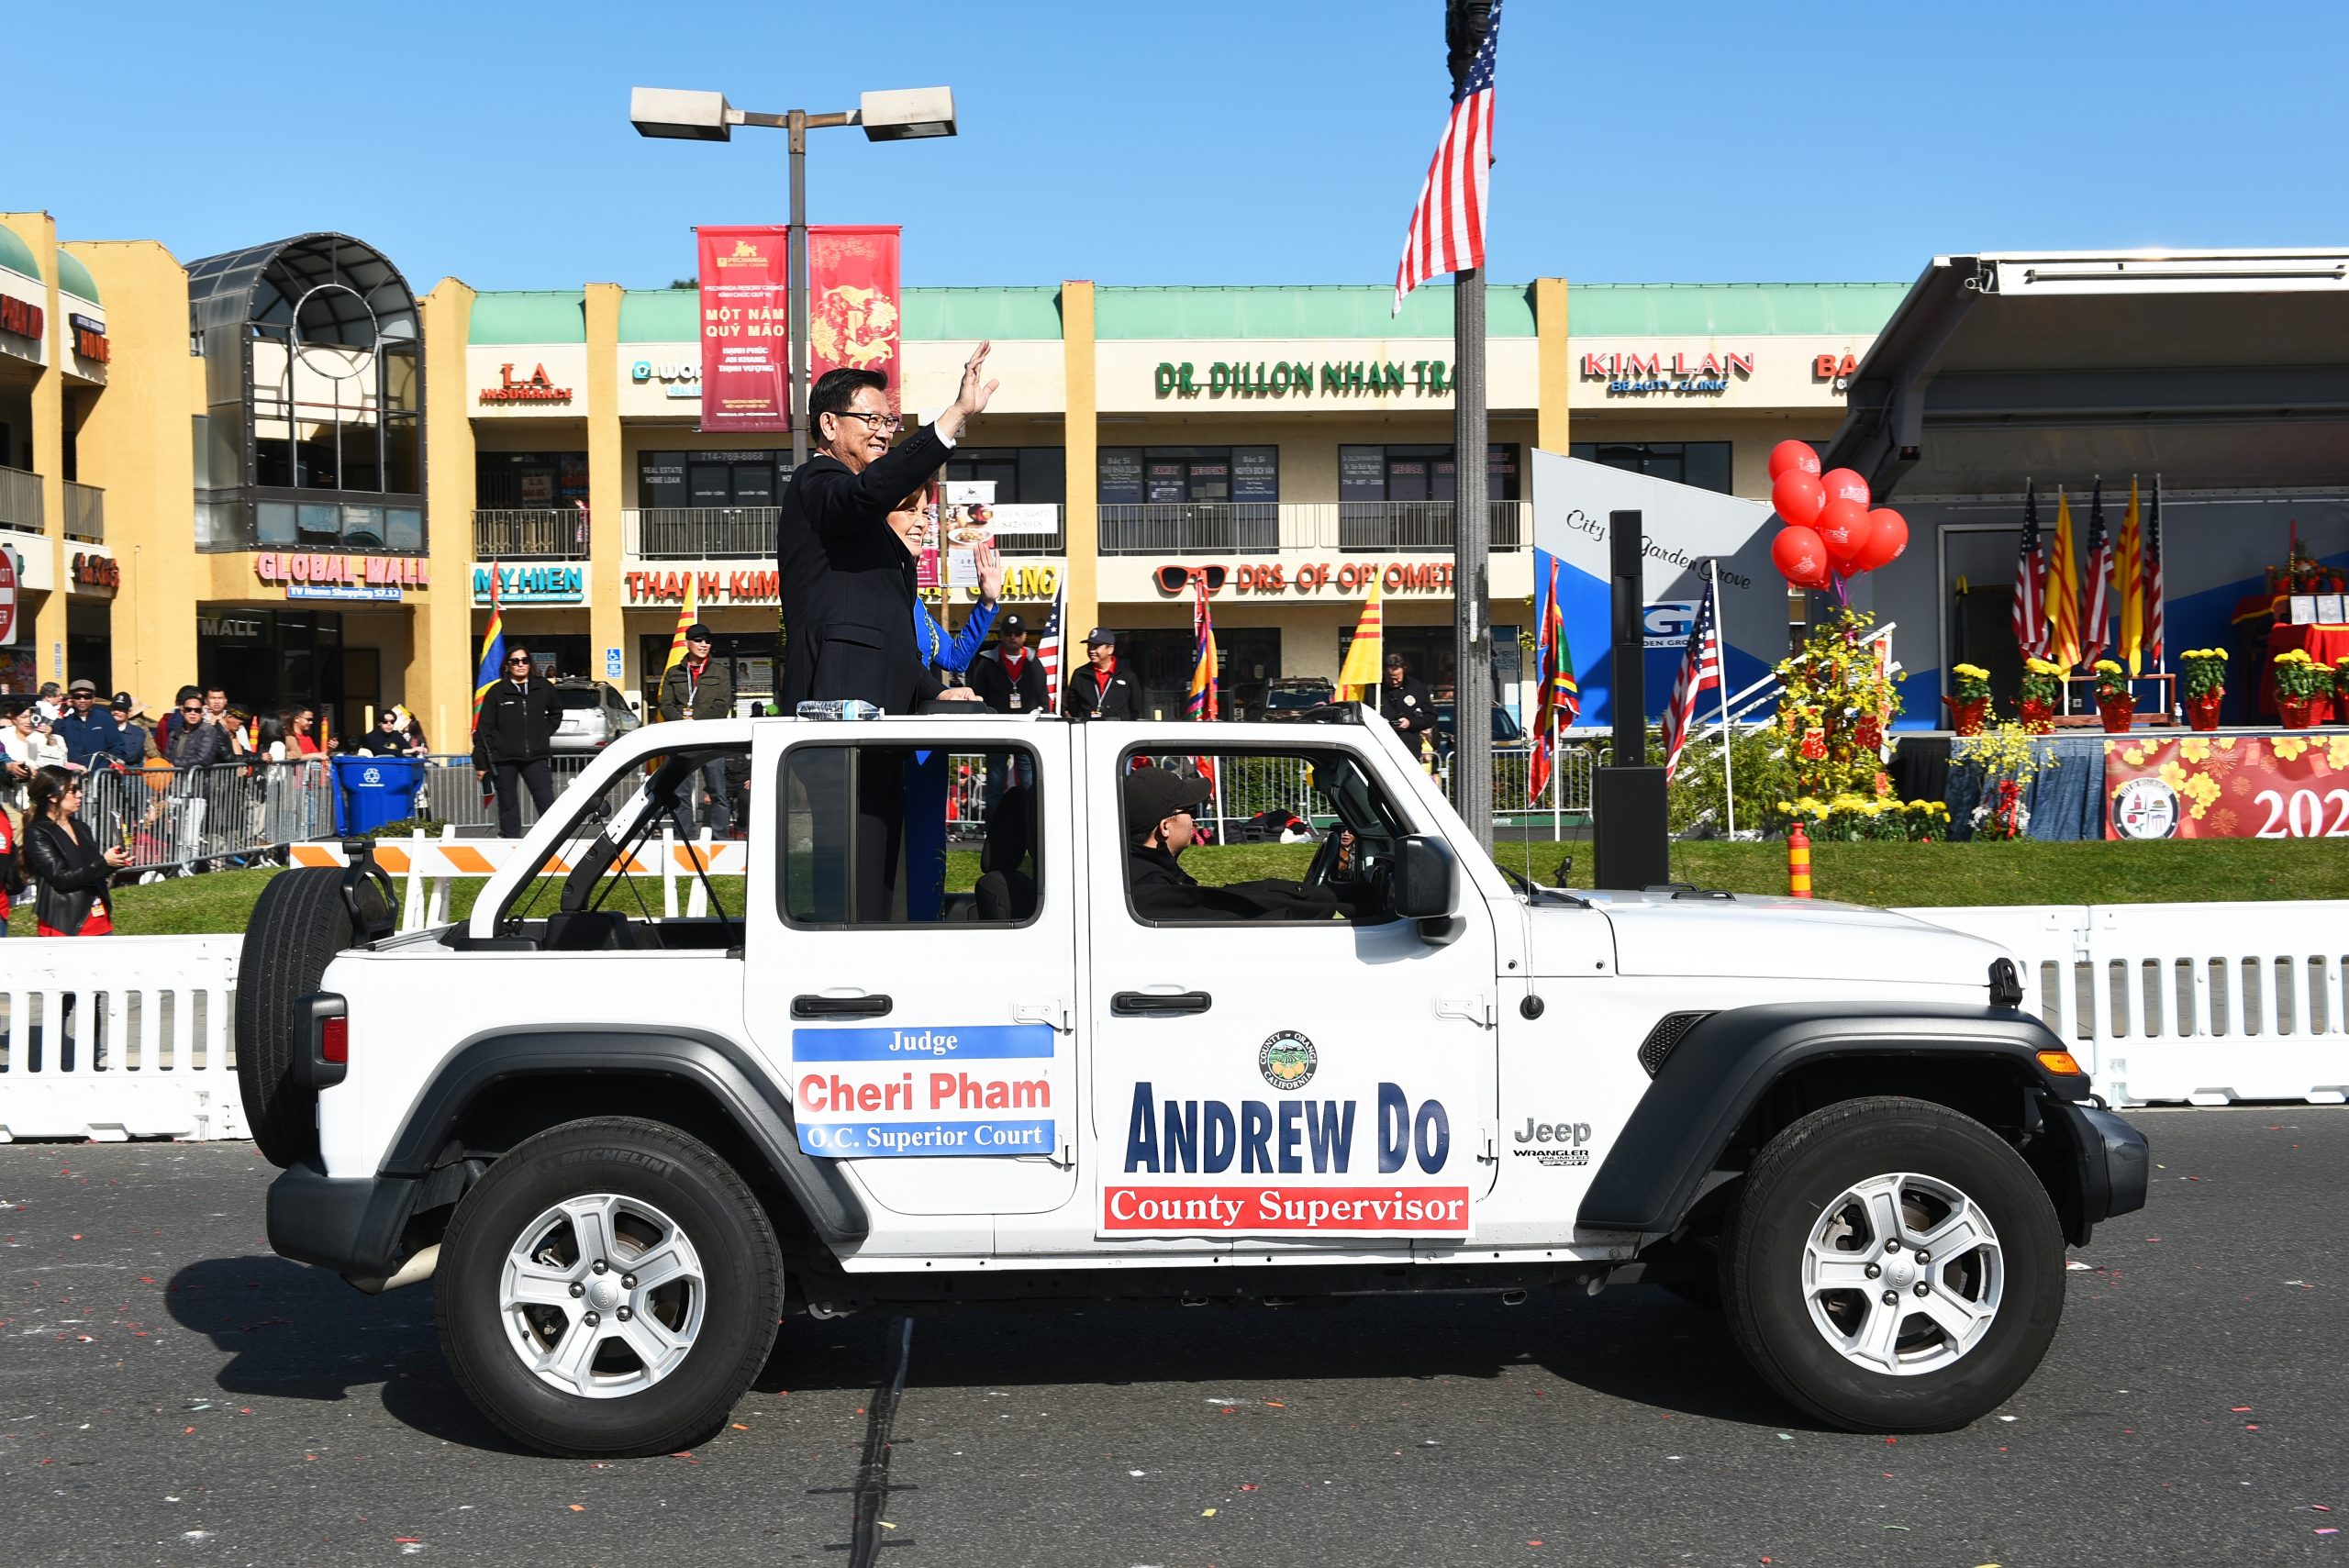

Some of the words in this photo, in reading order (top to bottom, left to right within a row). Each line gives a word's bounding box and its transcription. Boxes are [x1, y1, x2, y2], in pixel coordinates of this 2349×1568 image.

[706, 306, 740, 322] MỘT
[748, 306, 785, 320] NĂM
[748, 323, 785, 337] MÃO
[502, 362, 553, 386] LA
[1583, 351, 1663, 375] KIM
[1674, 351, 1754, 375] LAN
[1158, 361, 1202, 393] DR.
[1210, 361, 1314, 392] DILLON
[1324, 360, 1405, 391] NHAN
[1610, 380, 1673, 392] BEAUTY
[1679, 379, 1729, 391] CLINIC
[480, 387, 573, 399] INSURANCE
[1565, 509, 1606, 541] City
[1698, 558, 1752, 590] Grove
[257, 552, 357, 581] GLOBAL
[364, 555, 429, 584] MALL
[518, 567, 583, 591] HIEN
[1239, 563, 1286, 590] DRS.
[1297, 562, 1330, 589] OF
[1339, 562, 1454, 589] OPOMET
[290, 586, 304, 595] TV
[305, 587, 331, 596] Home
[331, 587, 373, 598] Shopping
[730, 571, 779, 597] KIM
[201, 619, 258, 636] MALL
[888, 1030, 958, 1055] Judge
[1260, 1032, 1281, 1064] COUNTY
[1294, 1032, 1317, 1064] ORANGE
[798, 1072, 913, 1112] Cheri
[930, 1072, 1051, 1110] Pham
[1264, 1071, 1313, 1090] CALIFORNIA
[807, 1127, 860, 1148] O.C.
[867, 1126, 967, 1152] Superior
[974, 1125, 1043, 1146] Court
[1123, 1082, 1357, 1174] ANDREW
[1514, 1117, 1592, 1147] Jeep
[561, 1148, 667, 1173] MICHELIN
[1109, 1190, 1246, 1227] County
[1258, 1190, 1464, 1227] Supervisor
